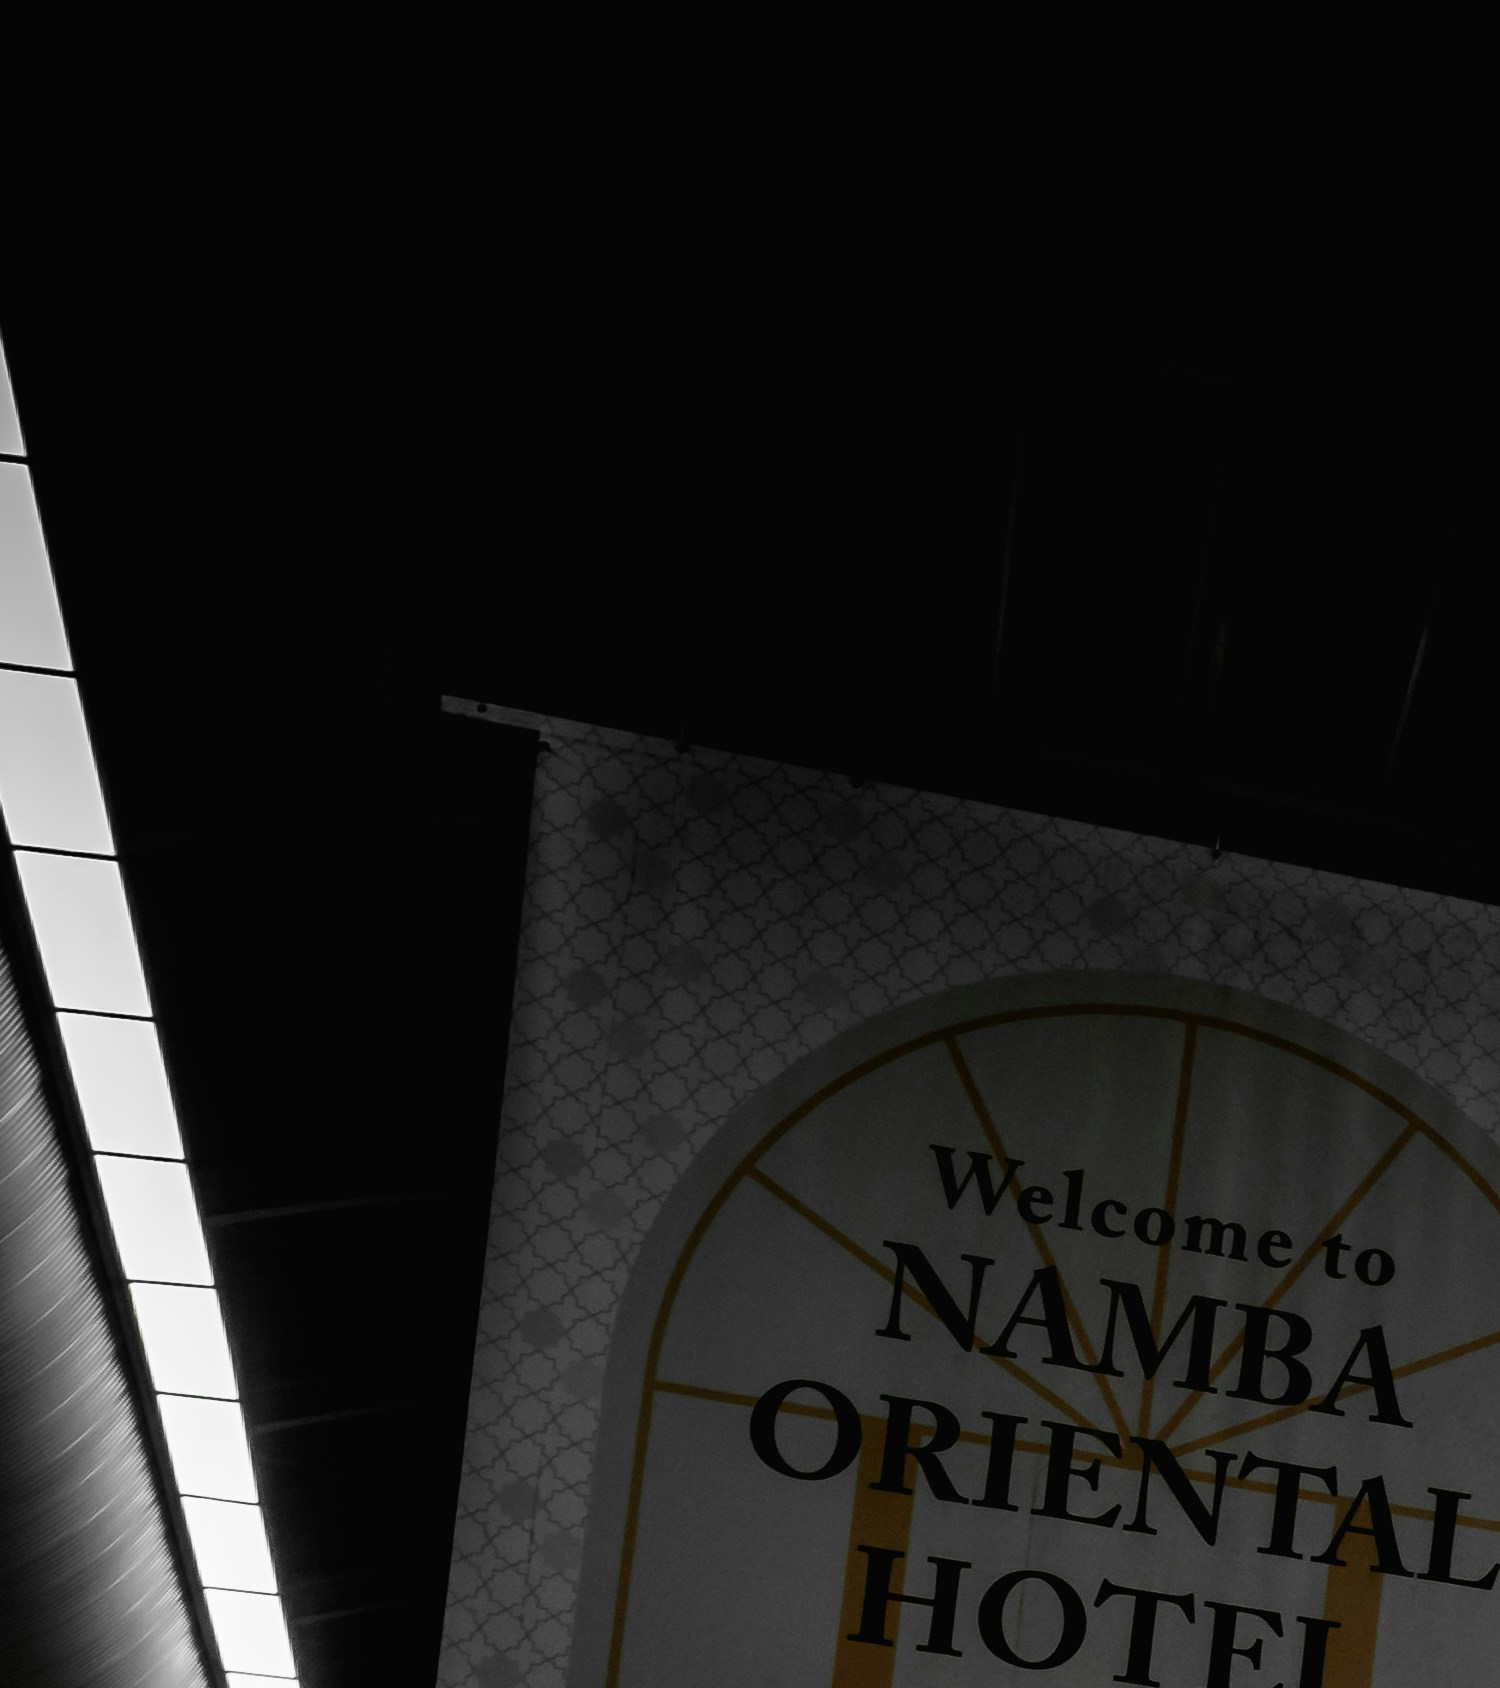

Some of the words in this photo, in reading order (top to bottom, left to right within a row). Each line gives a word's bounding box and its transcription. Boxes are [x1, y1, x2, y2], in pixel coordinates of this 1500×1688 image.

[929, 1142, 1294, 1271] Welcome
[1322, 1230, 1397, 1290] to
[875, 1240, 1414, 1430] NAMBA
